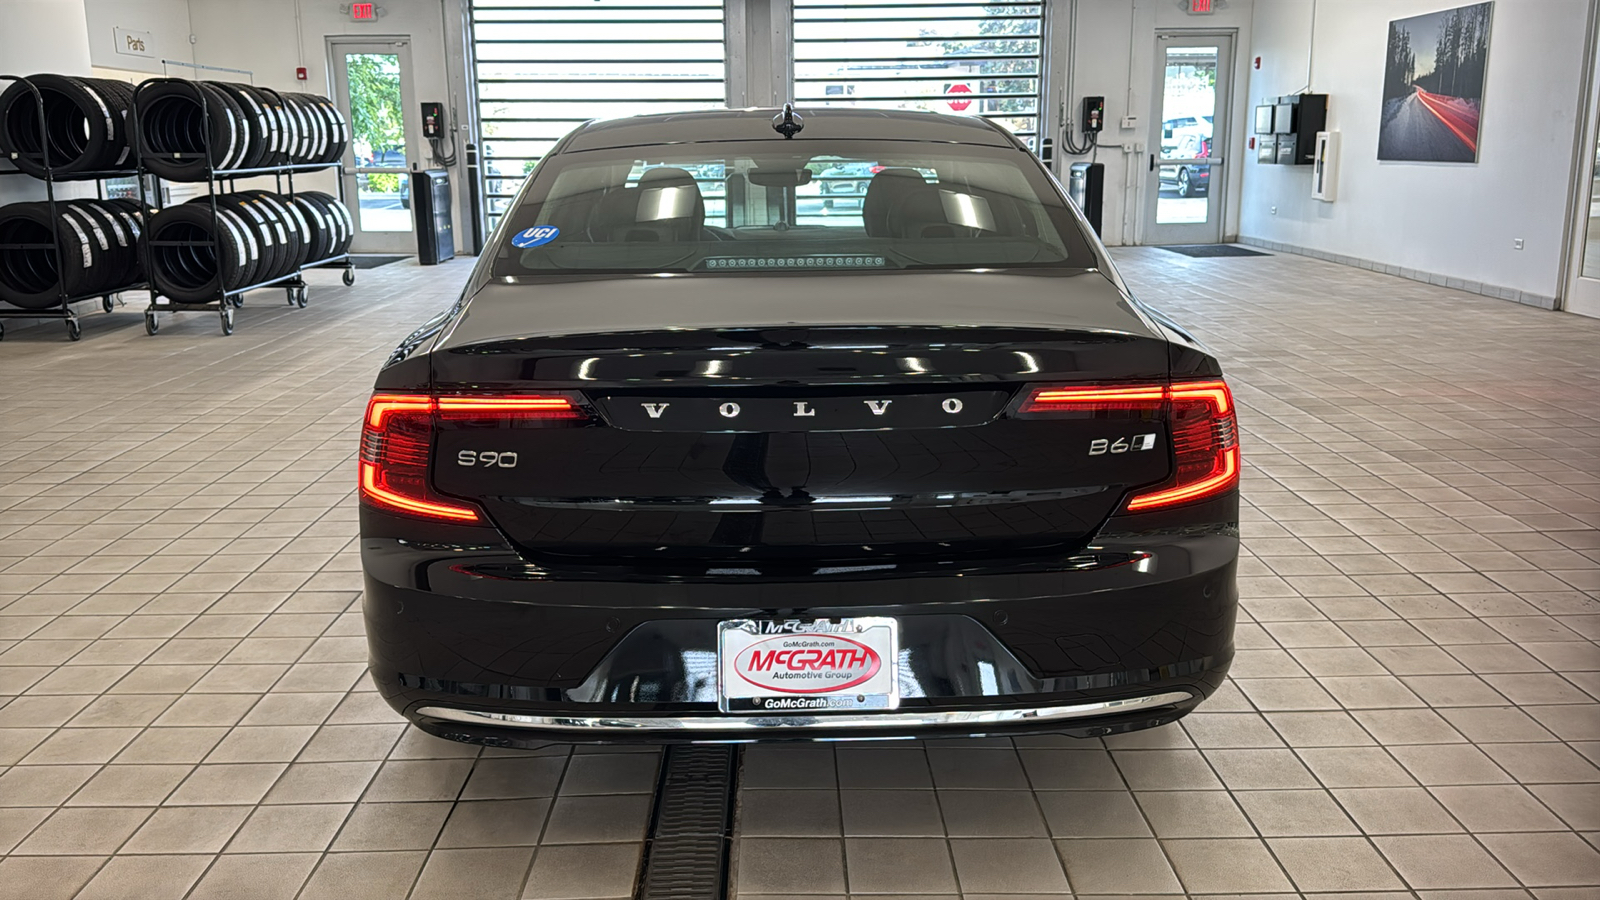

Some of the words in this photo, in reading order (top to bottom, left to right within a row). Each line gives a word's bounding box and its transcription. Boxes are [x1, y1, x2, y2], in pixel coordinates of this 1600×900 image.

[353, 3, 372, 18] EXIT
[1192, 0, 1210, 11] EXIT
[127, 35, 145, 51] Parts
[523, 227, 557, 238] UCI
[641, 398, 963, 418] VOLVO
[458, 450, 518, 467] S90
[772, 671, 823, 680] Automotive
[825, 672, 852, 680] Group
[765, 697, 853, 709] GoMcGrath.com
